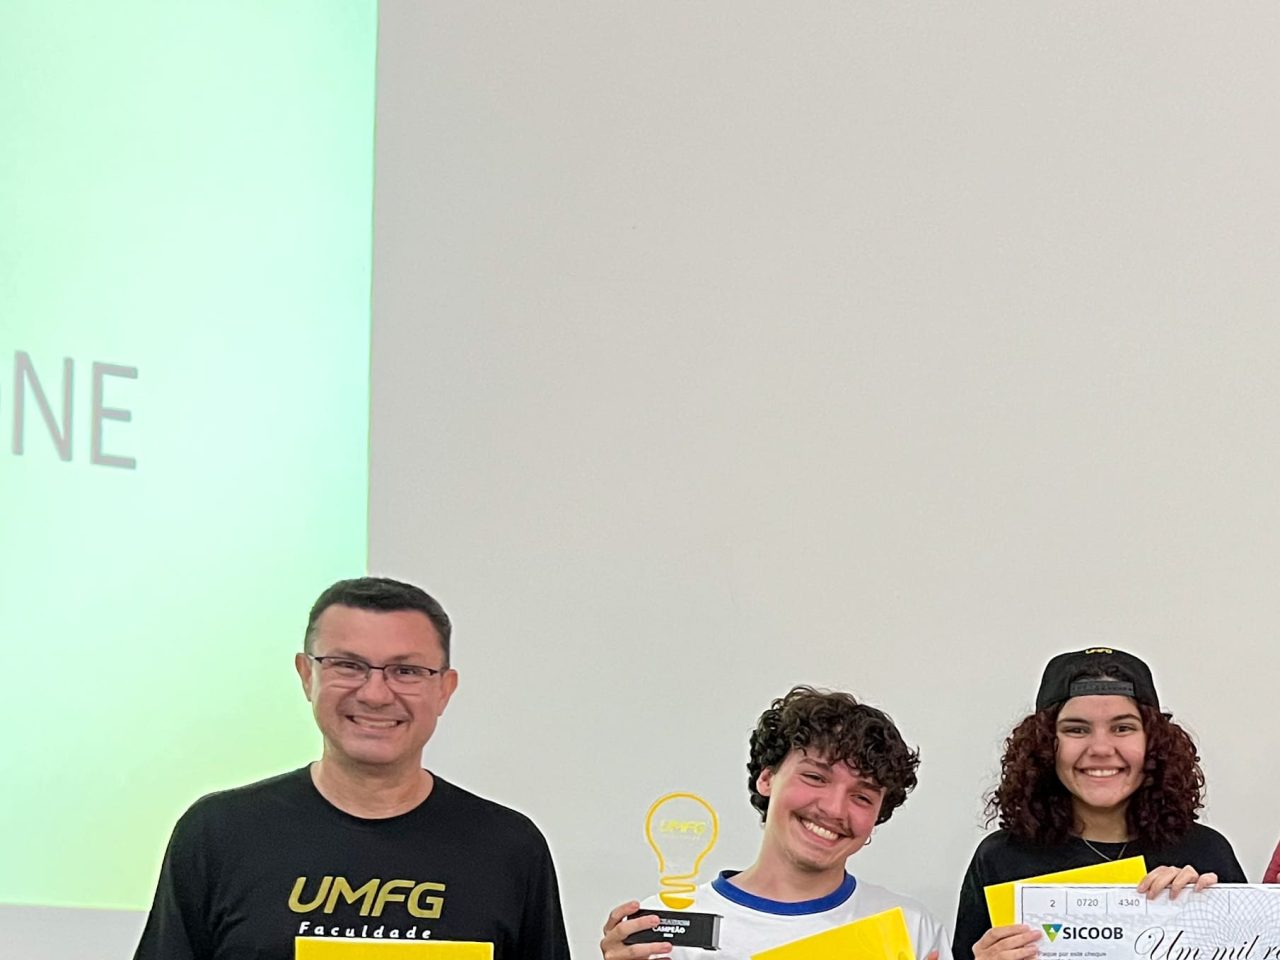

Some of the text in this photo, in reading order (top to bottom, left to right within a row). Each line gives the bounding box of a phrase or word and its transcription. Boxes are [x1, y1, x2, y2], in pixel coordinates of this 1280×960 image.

[288, 876, 446, 919] UMFG
[1050, 900, 1056, 908] 2
[1077, 898, 1099, 907] 0720
[1118, 898, 1140, 907] 4340
[299, 921, 432, 939] Faculdade
[1062, 926, 1124, 940] SICOOB
[1211, 934, 1260, 960] mil
